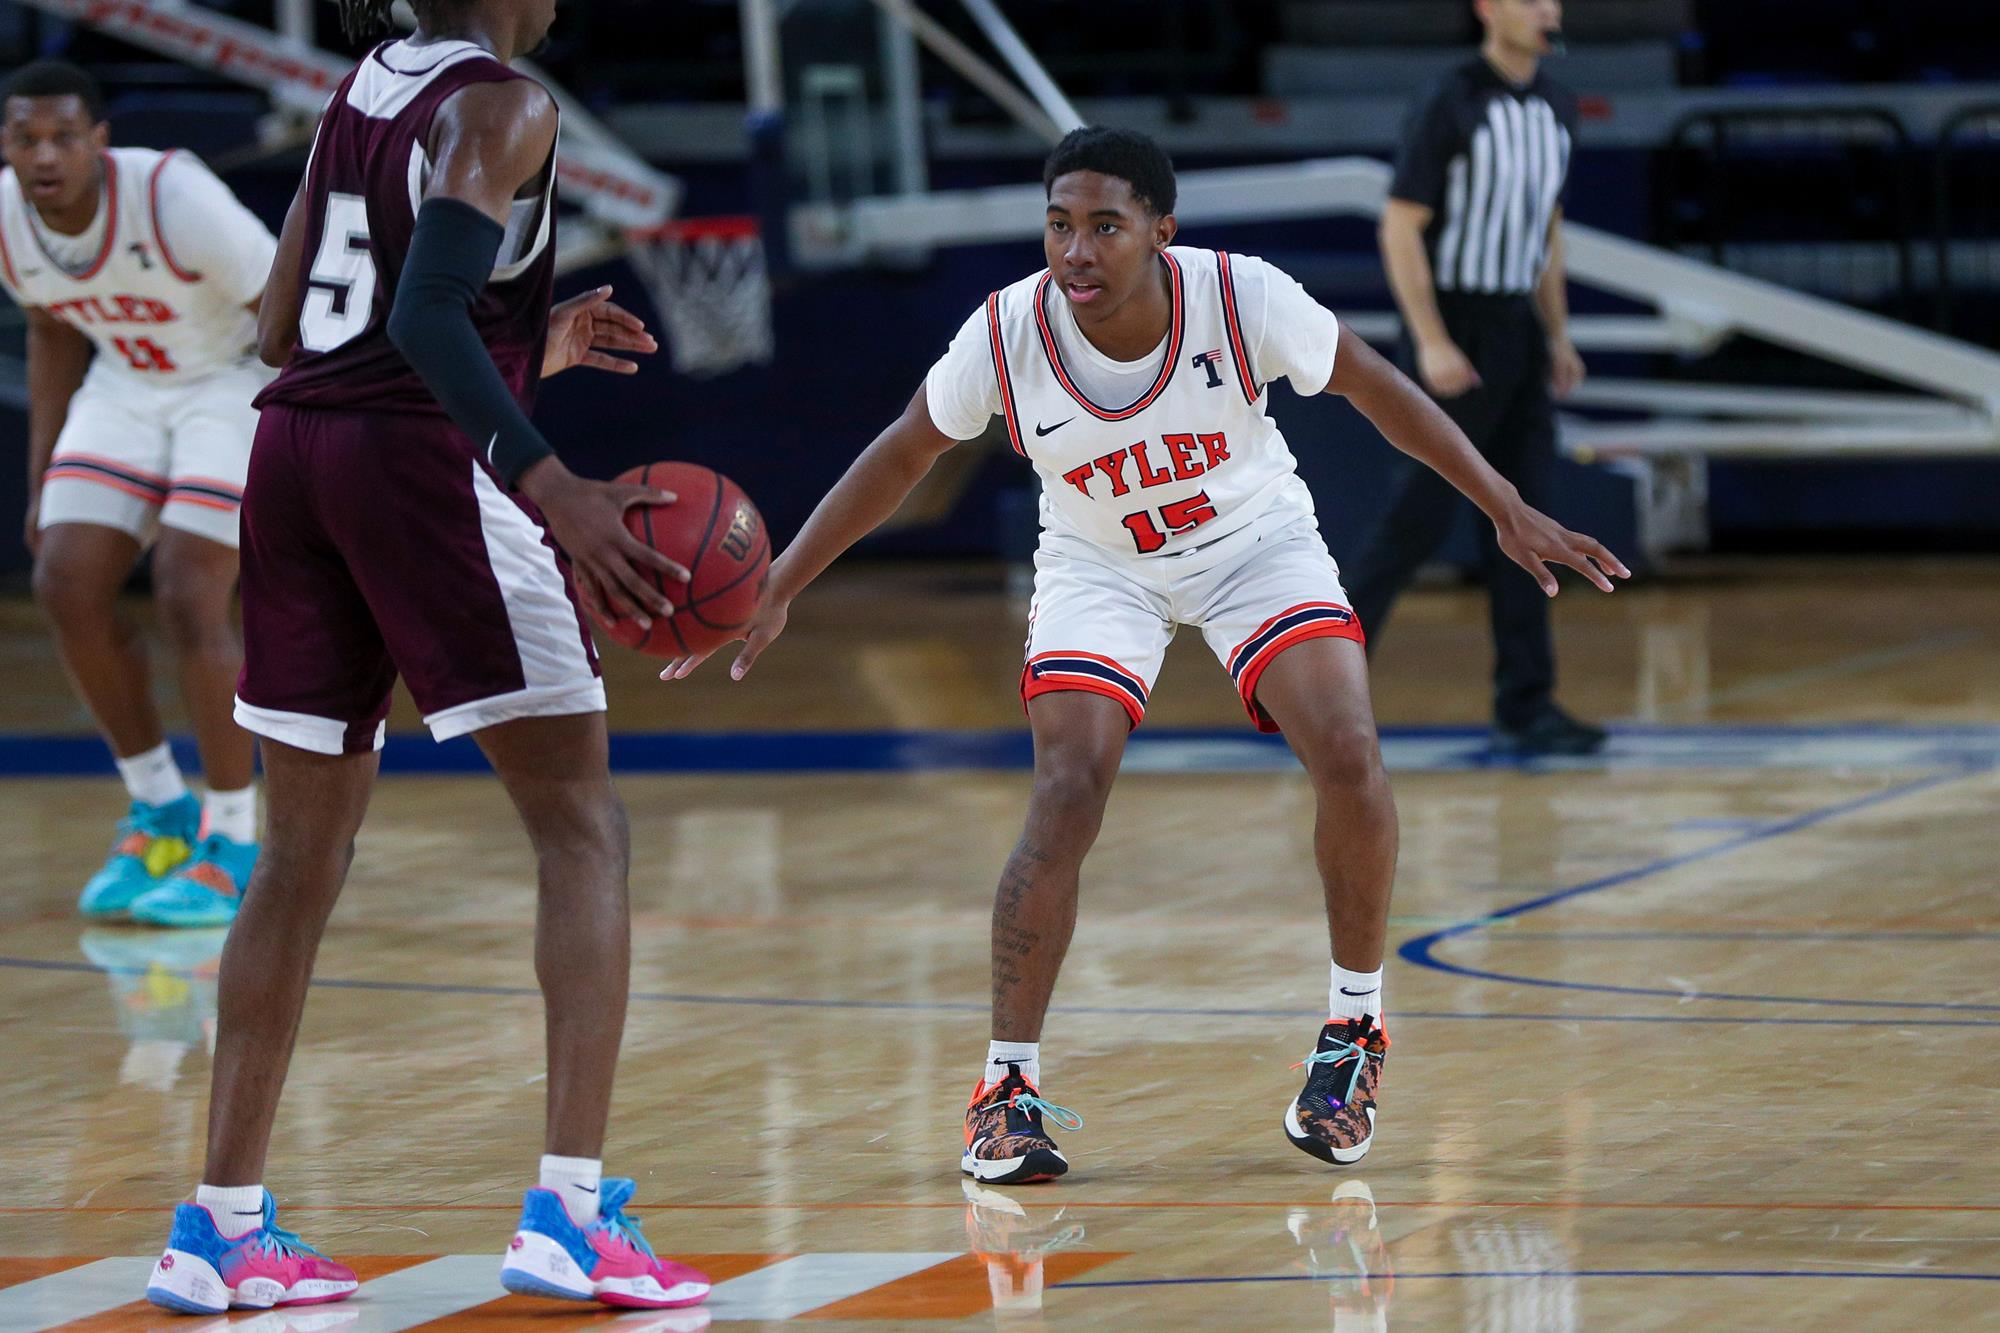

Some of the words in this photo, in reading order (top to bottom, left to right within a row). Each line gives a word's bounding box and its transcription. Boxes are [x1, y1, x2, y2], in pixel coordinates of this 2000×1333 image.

[299, 191, 377, 353] 5
[1191, 349, 1227, 388] T
[1062, 431, 1231, 500] TYLER
[1122, 489, 1218, 554] 15
